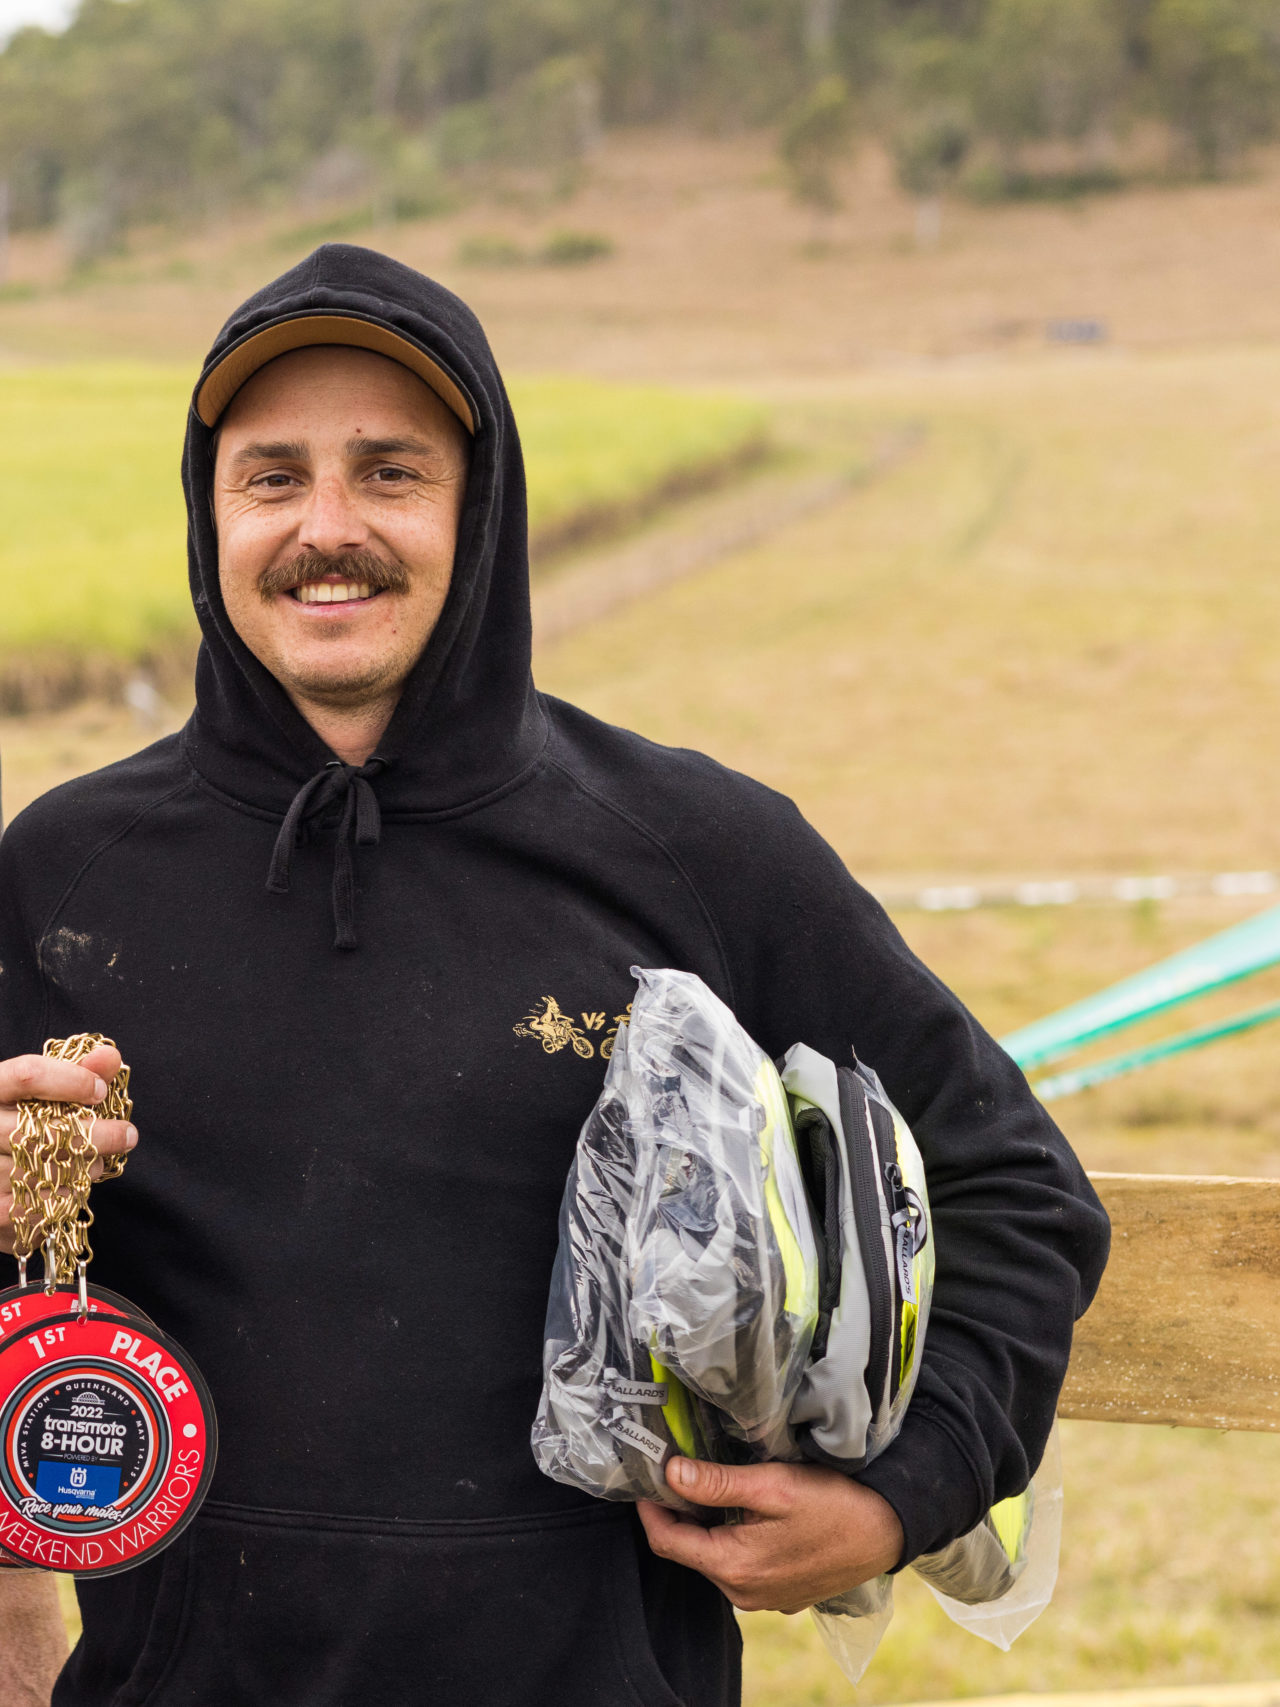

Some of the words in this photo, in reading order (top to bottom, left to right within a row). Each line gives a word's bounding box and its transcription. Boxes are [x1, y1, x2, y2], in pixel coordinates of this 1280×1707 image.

[581, 1012, 606, 1031] VS
[28, 1327, 66, 1359] 1ST
[110, 1331, 188, 1403] PLACE
[65, 1382, 130, 1406] QUEENSLAND
[23, 1396, 50, 1435] STATION
[70, 1405, 103, 1419] 2022
[44, 1414, 127, 1437] transmoto
[136, 1420, 145, 1440] MAY
[20, 1441, 30, 1468] MIVA
[41, 1432, 124, 1456] 8-HOUR
[63, 1453, 91, 1462] POWERED
[58, 1486, 96, 1497] Husqvarna
[109, 1449, 200, 1556] WARRIORS
[19, 1497, 51, 1518] Race
[52, 1503, 83, 1518] your
[84, 1505, 131, 1522] mates!
